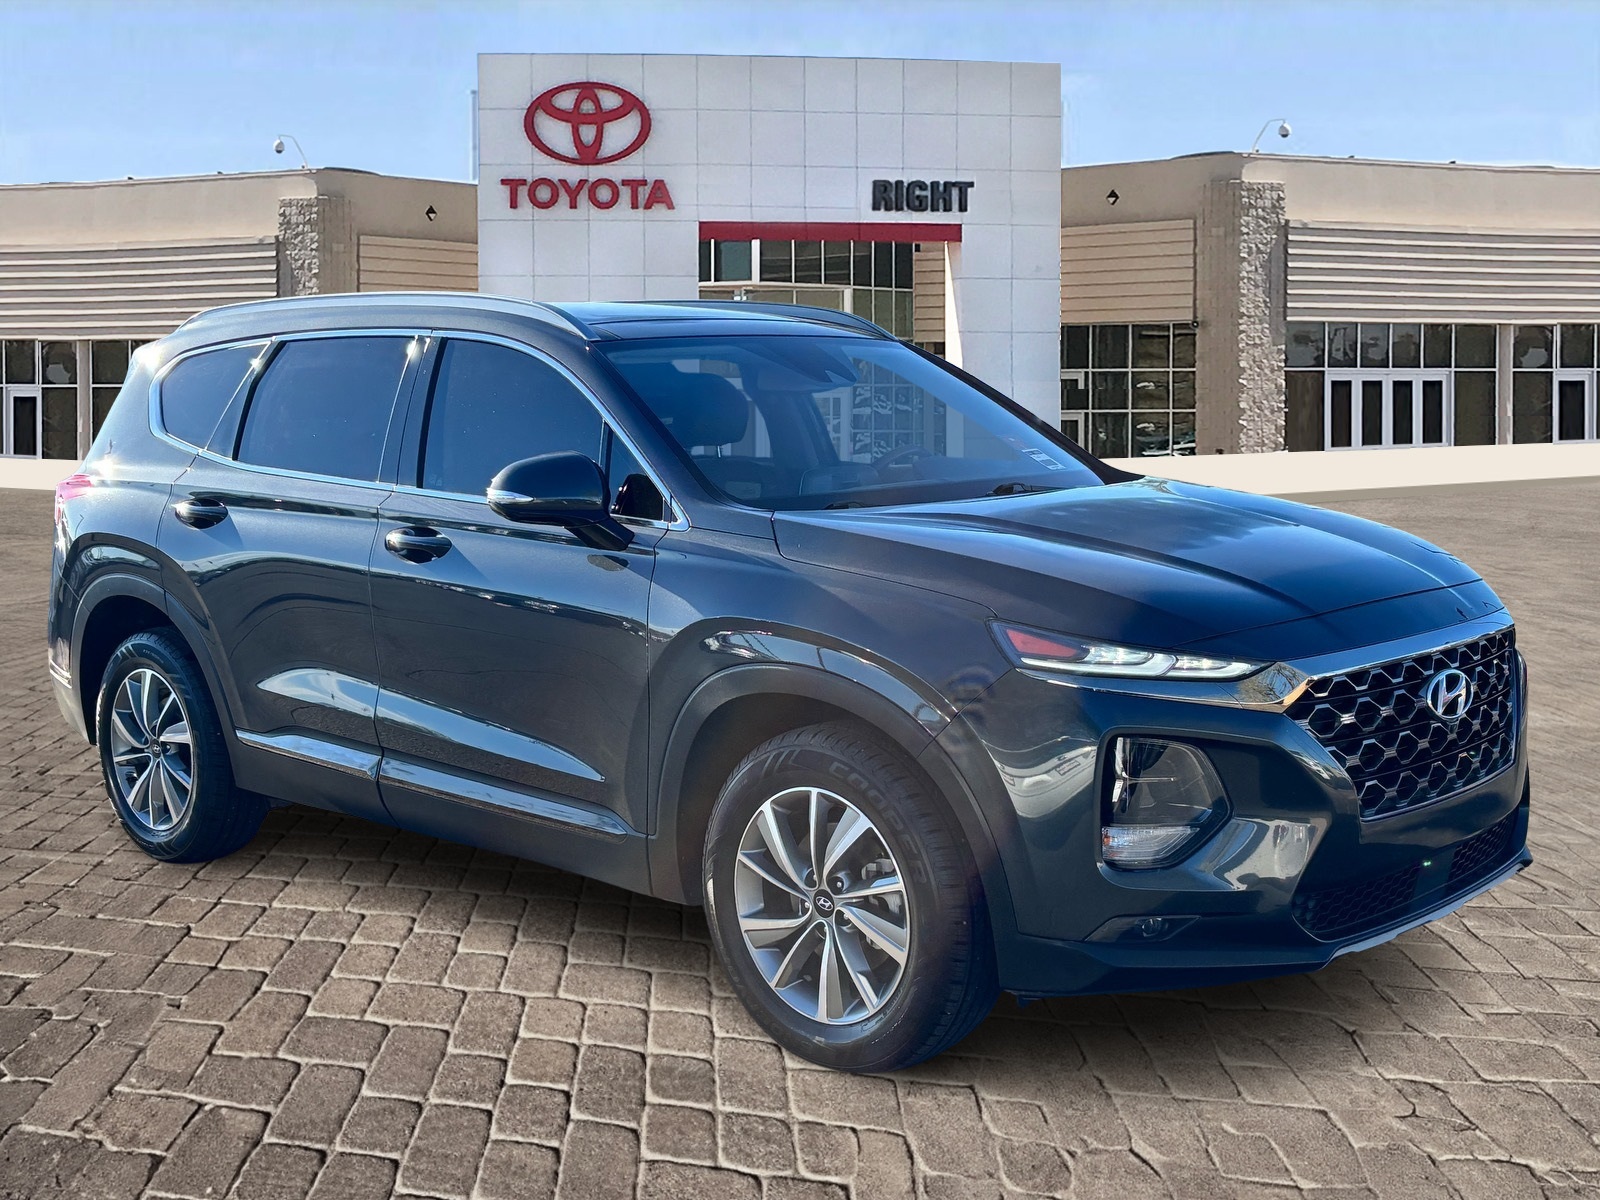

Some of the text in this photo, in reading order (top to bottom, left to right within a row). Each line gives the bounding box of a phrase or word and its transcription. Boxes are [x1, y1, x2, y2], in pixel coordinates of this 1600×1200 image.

[500, 178, 675, 210] TOYOTA
[872, 180, 974, 212] RIGHT
[829, 761, 927, 884] COOPER
